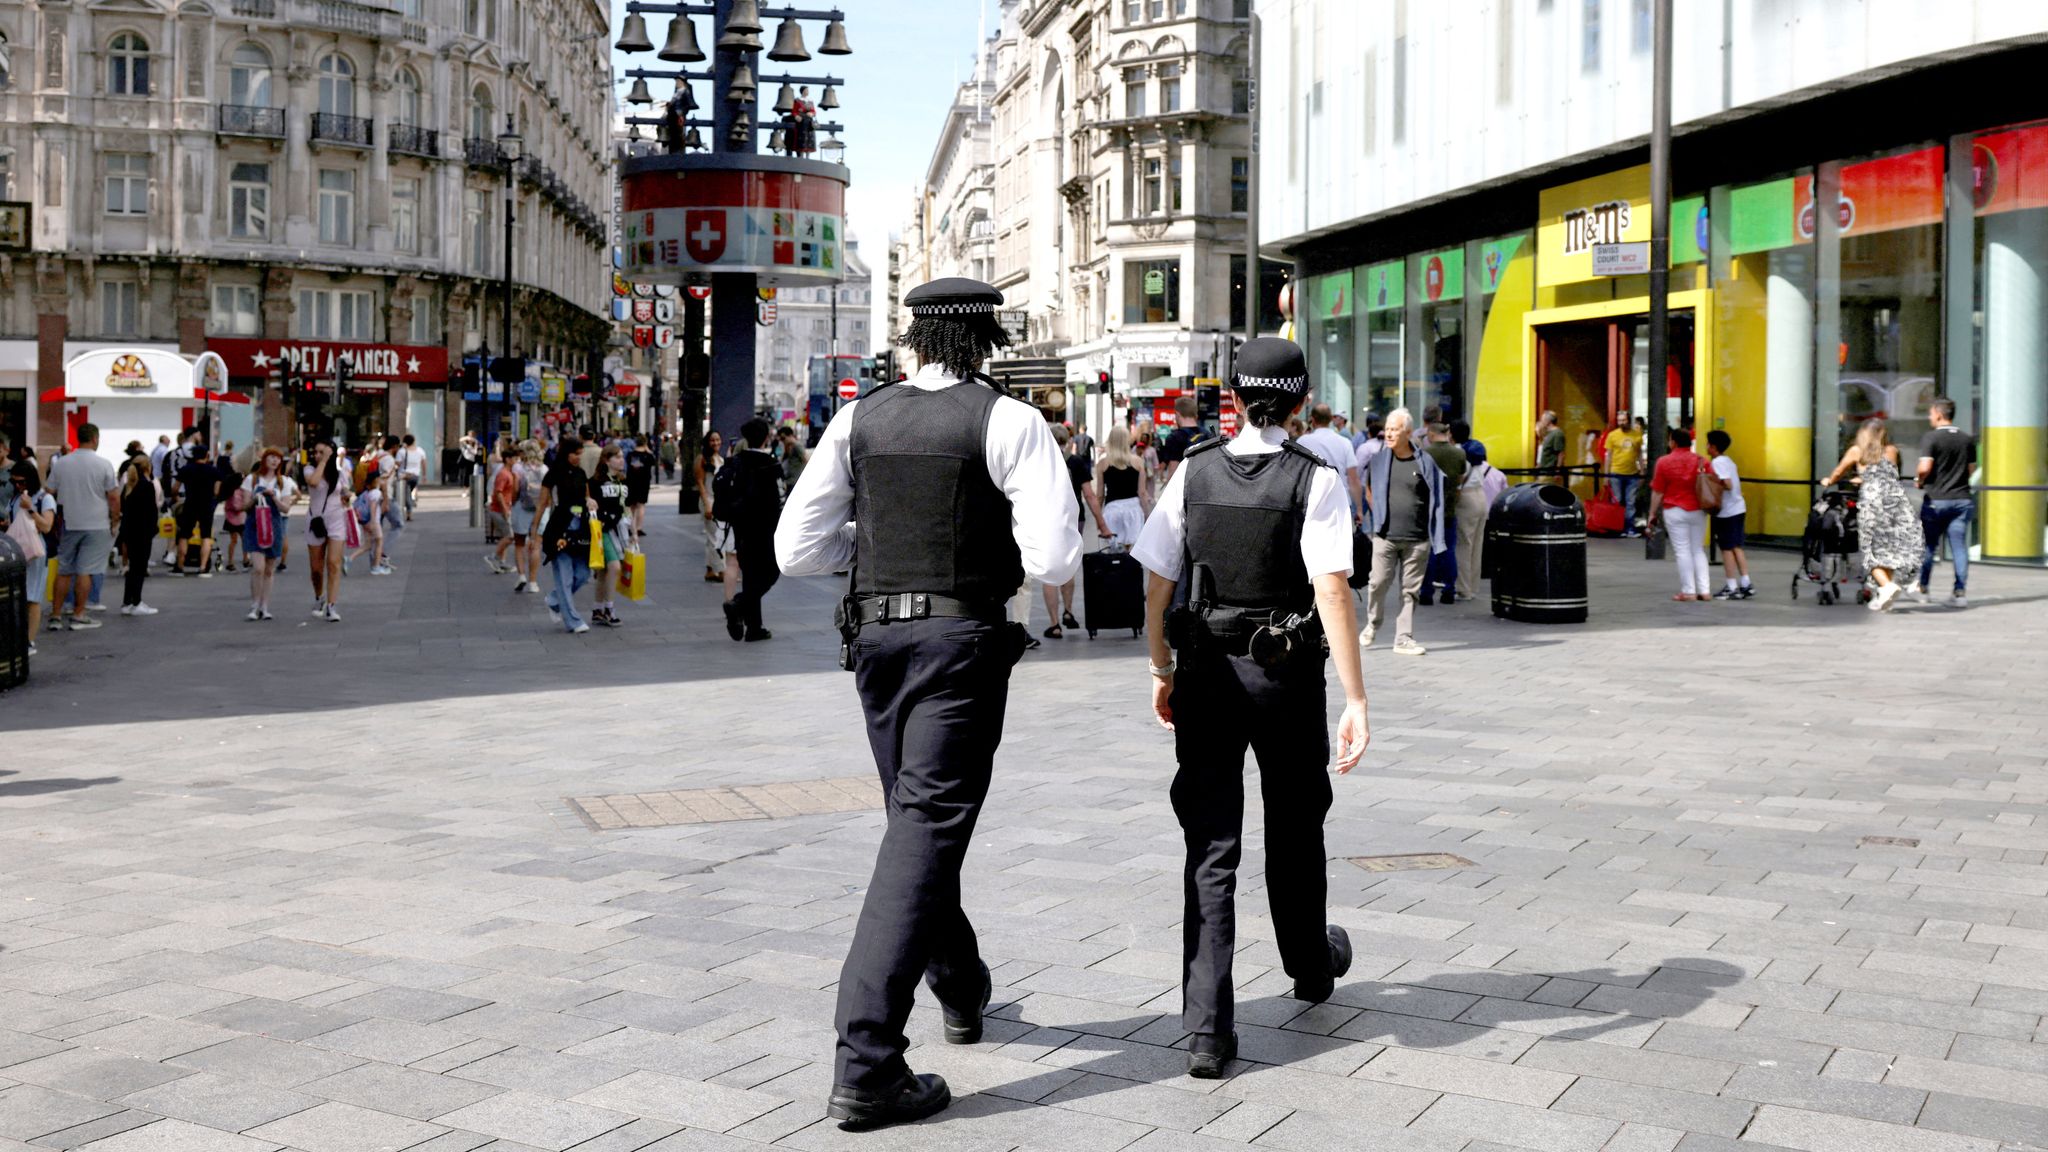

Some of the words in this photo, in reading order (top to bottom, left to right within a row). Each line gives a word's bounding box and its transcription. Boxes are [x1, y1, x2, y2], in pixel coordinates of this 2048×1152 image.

[1597, 246, 1619, 254] SWISS
[1597, 255, 1619, 263] COURT
[280, 345, 321, 372] PRET
[325, 348, 337, 373] A
[339, 348, 400, 376] MANGER
